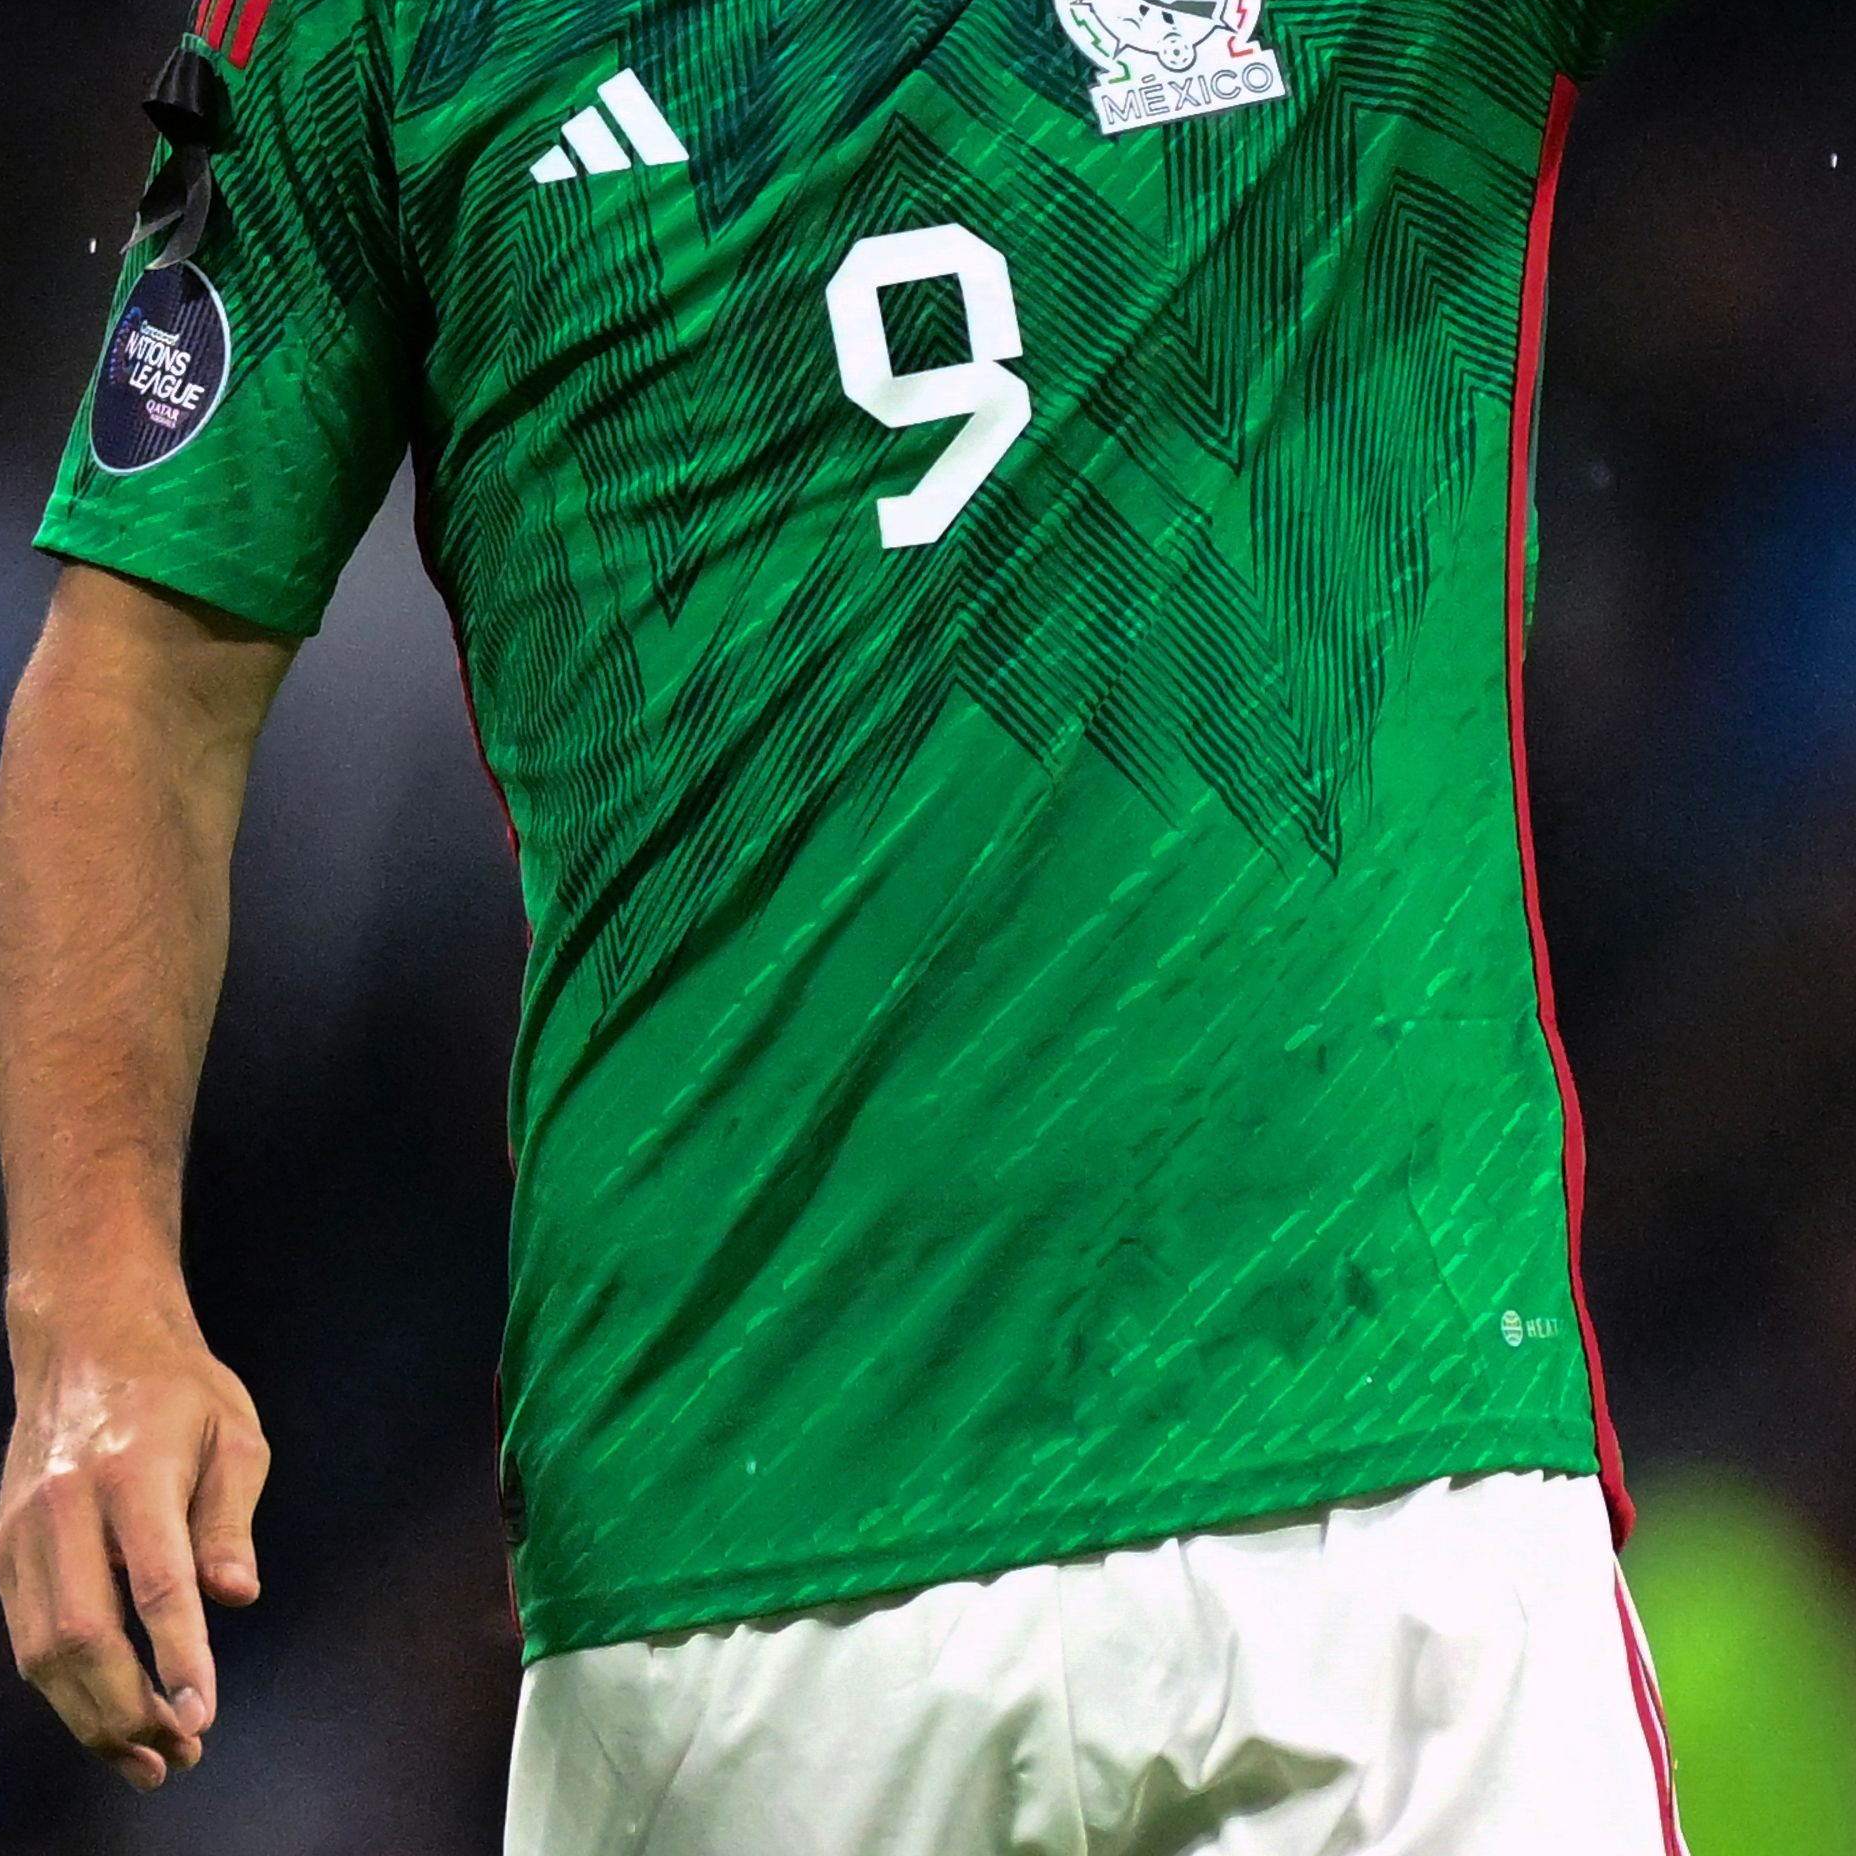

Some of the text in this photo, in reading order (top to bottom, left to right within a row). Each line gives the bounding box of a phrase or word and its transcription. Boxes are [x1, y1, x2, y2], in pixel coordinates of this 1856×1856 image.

[1100, 62, 1274, 126] MÉXICO
[124, 330, 191, 376] NATIONS
[129, 361, 205, 410] LEAGUE
[825, 223, 1032, 549] 9
[145, 399, 180, 422] QATAR
